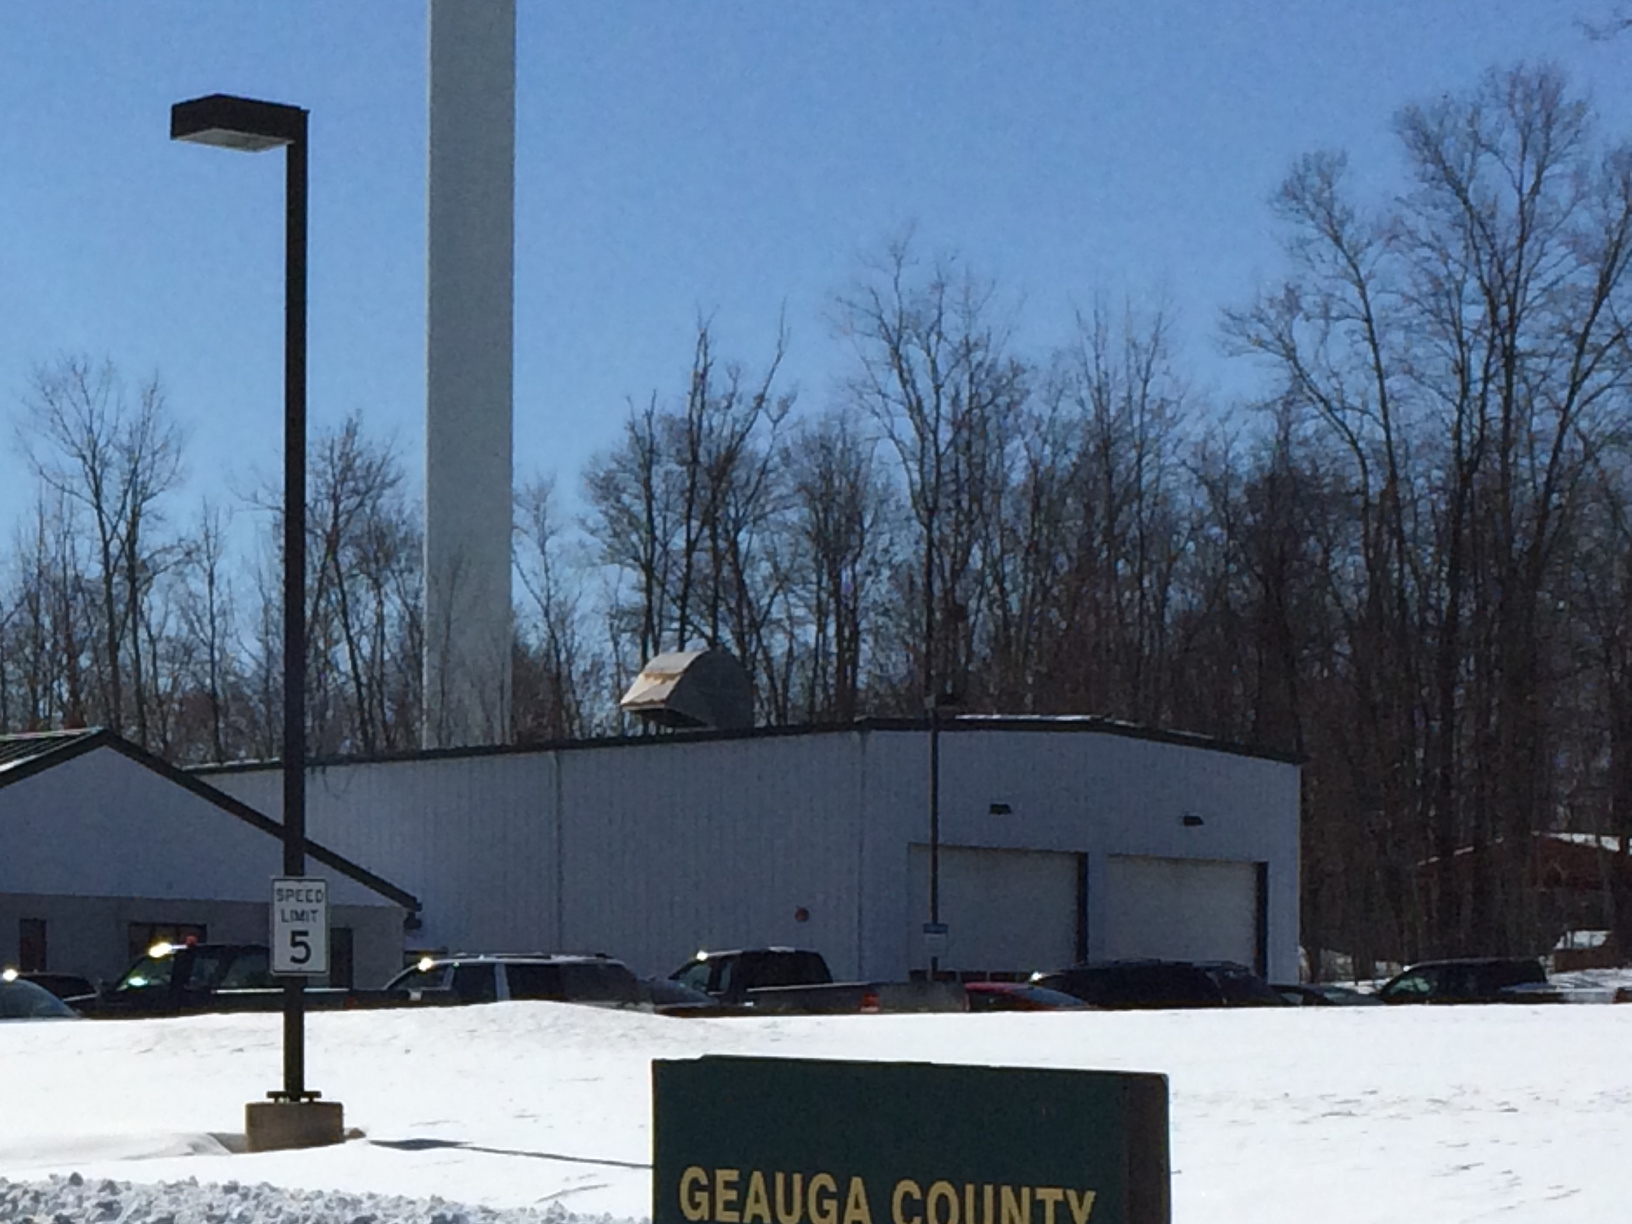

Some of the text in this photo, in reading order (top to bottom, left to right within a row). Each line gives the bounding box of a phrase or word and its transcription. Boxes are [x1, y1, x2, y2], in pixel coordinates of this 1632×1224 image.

[276, 888, 324, 903] SPEED
[280, 909, 319, 923] LIMIT
[289, 930, 311, 965] 5
